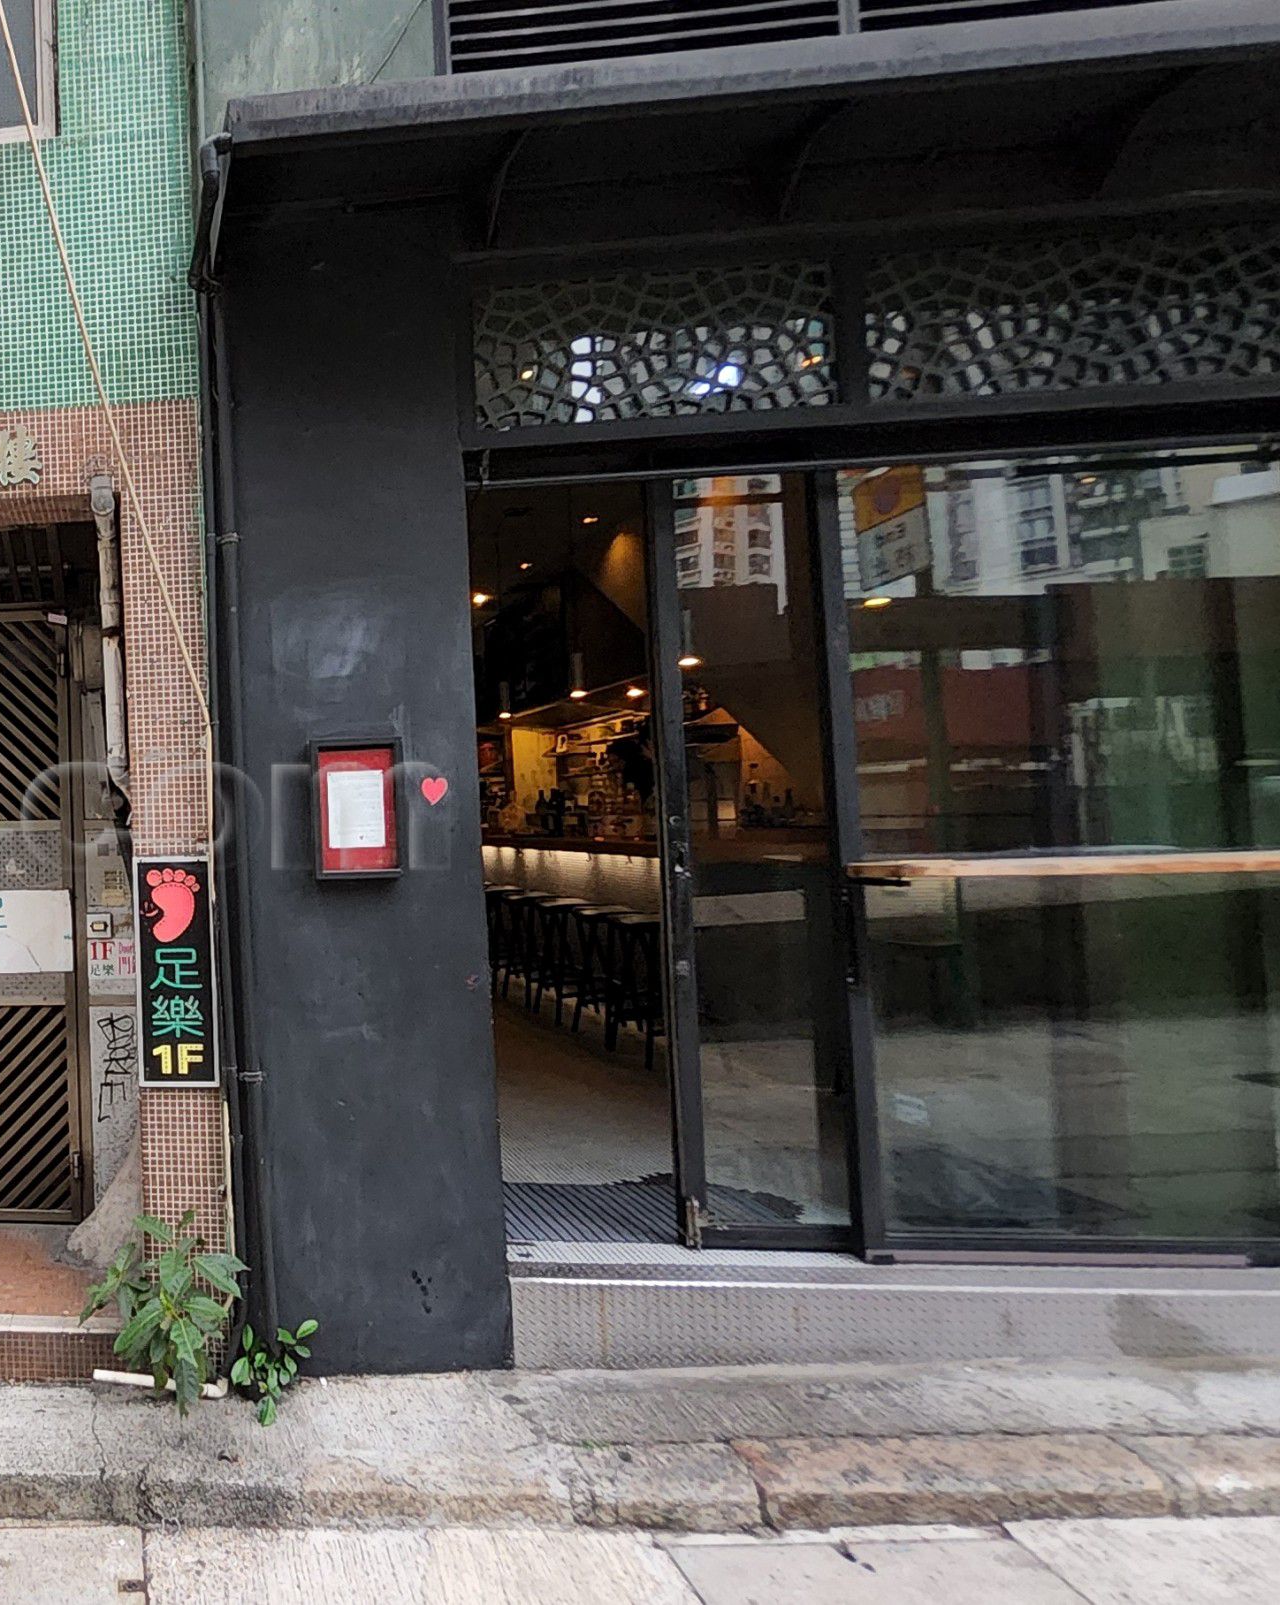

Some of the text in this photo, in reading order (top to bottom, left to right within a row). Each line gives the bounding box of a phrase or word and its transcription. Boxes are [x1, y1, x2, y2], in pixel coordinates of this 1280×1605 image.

[91, 941, 115, 960] 1F
[150, 948, 204, 1038] 足樂
[152, 1043, 204, 1075] 1F
